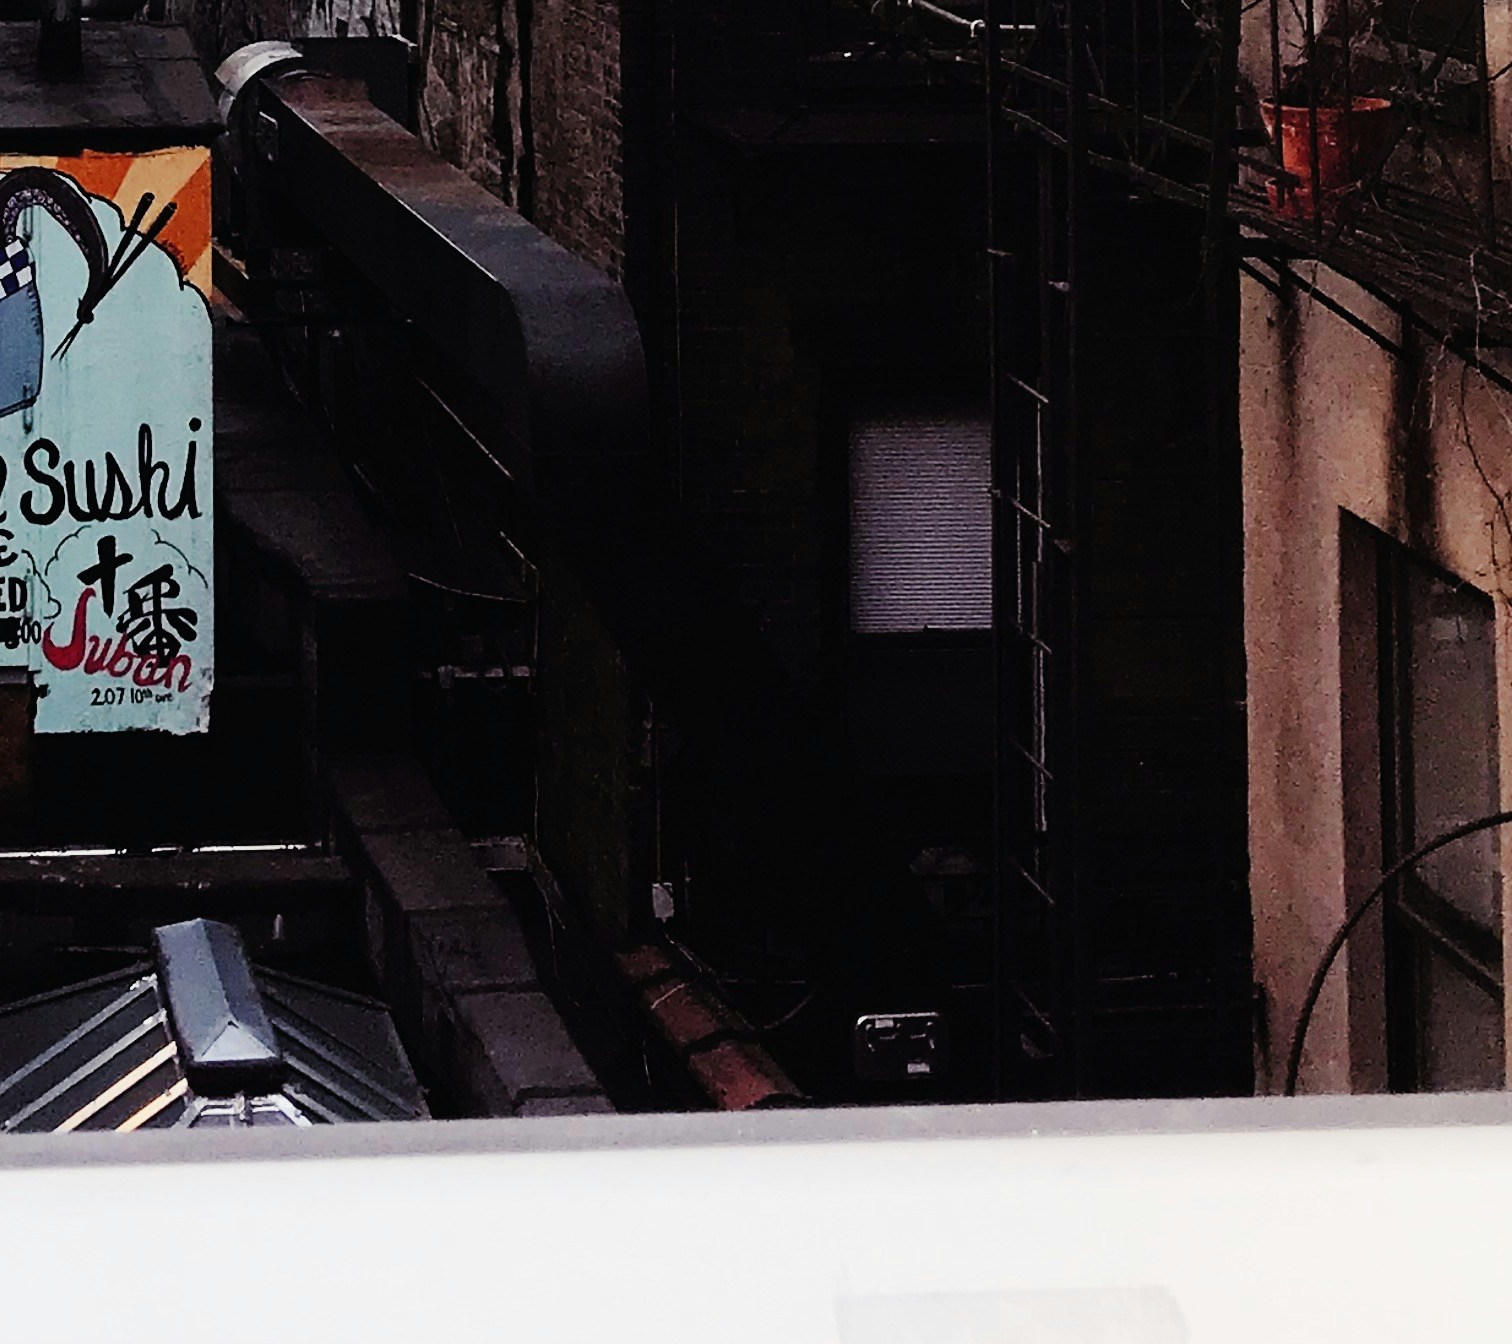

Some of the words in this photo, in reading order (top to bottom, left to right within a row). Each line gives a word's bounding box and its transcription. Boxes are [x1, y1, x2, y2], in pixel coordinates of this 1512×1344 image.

[20, 417, 203, 526] Sushi
[42, 587, 193, 693] Juban
[90, 687, 126, 706] 207
